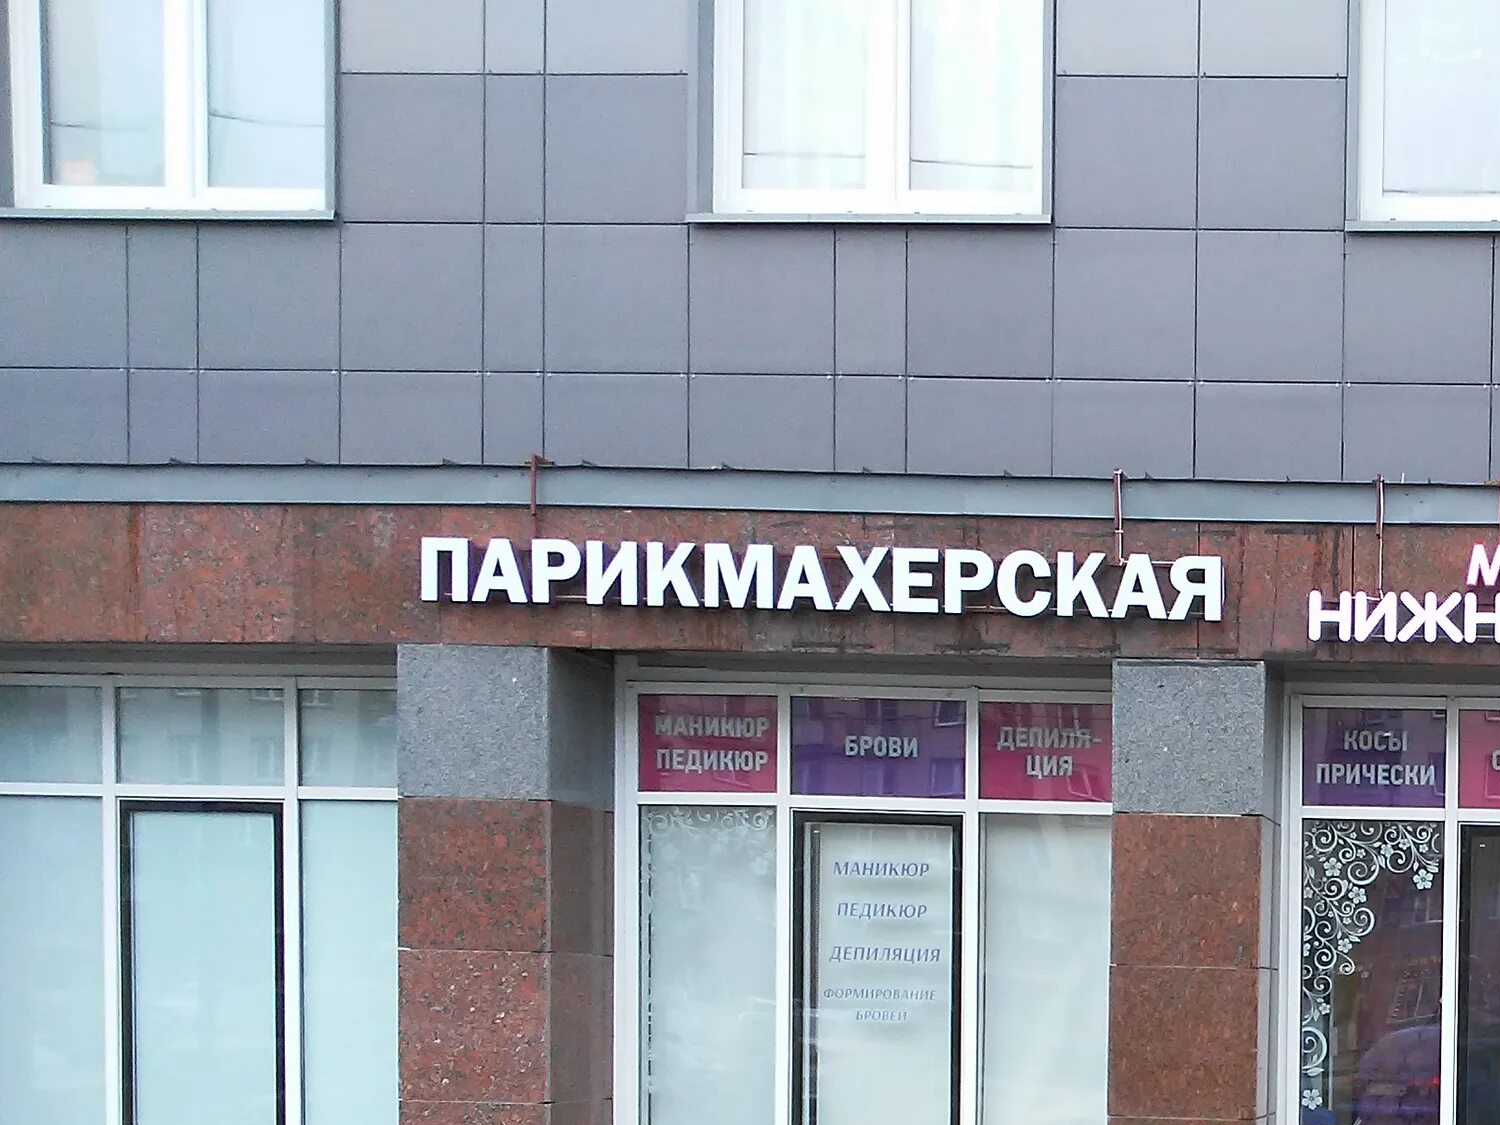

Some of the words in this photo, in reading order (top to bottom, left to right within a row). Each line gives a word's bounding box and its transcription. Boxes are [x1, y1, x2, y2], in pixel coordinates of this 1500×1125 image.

[420, 536, 1224, 622] ПАРИКМАХЕРСКАЯ
[655, 713, 770, 739] МАНИКЮР
[844, 735, 919, 758] БРОВИ
[1344, 729, 1408, 752] КОСЫ
[656, 749, 769, 773] ПЕДИКЮР
[1026, 756, 1073, 780] ЦИЯ
[1316, 763, 1435, 785] ПРИЧЕСКИ
[833, 862, 930, 877] МАНИКЮР
[837, 903, 927, 920] ПЕДИКЮР
[829, 946, 941, 964] ДЕПИЛЯЦИЯ
[823, 988, 937, 1001] ФОРМИРОВАНИЕ
